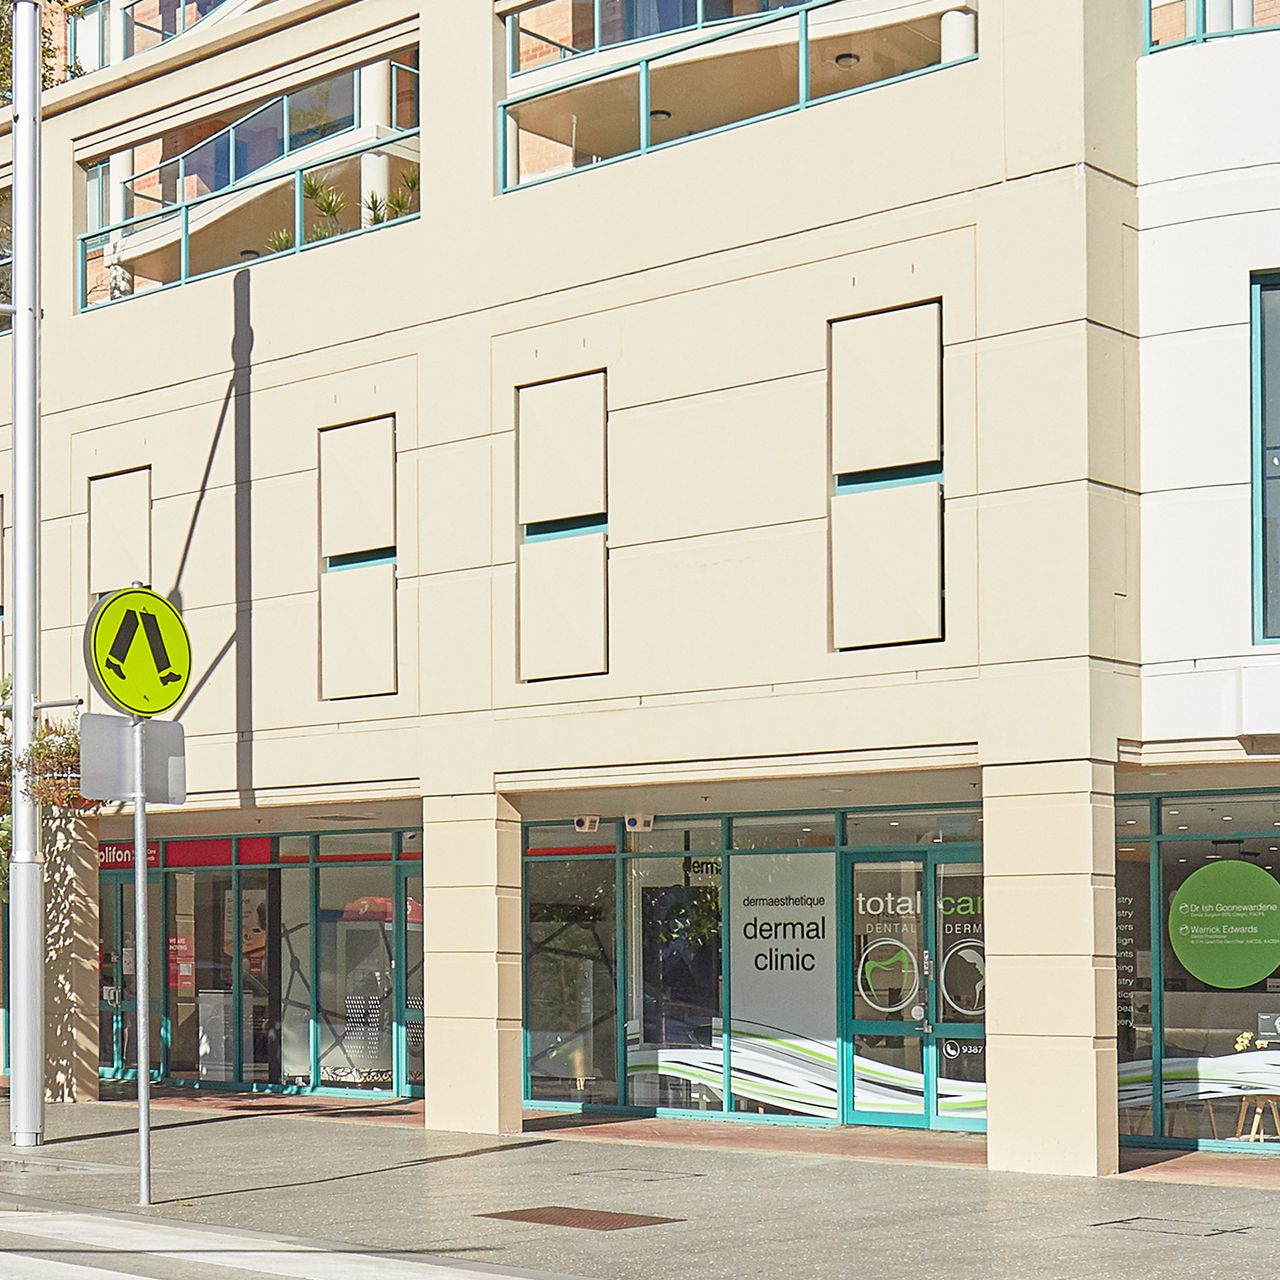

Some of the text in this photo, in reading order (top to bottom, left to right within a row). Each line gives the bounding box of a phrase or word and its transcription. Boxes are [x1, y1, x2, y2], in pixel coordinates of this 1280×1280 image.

[99, 846, 131, 863] plifon
[743, 895, 825, 908] dermaesthetique
[856, 890, 921, 915] total
[1117, 896, 1134, 905] stry
[1190, 904, 1199, 912] Dr
[1201, 903, 1214, 912] Ish
[1117, 910, 1134, 918] stry
[743, 916, 826, 940] dermal
[865, 923, 983, 934] DENTAL DERM
[1190, 924, 1258, 934] Warrick Edwards
[754, 948, 816, 971] clinic
[1117, 978, 1134, 986] stry
[1117, 991, 1134, 999] tics
[962, 1045, 983, 1054] 9387
